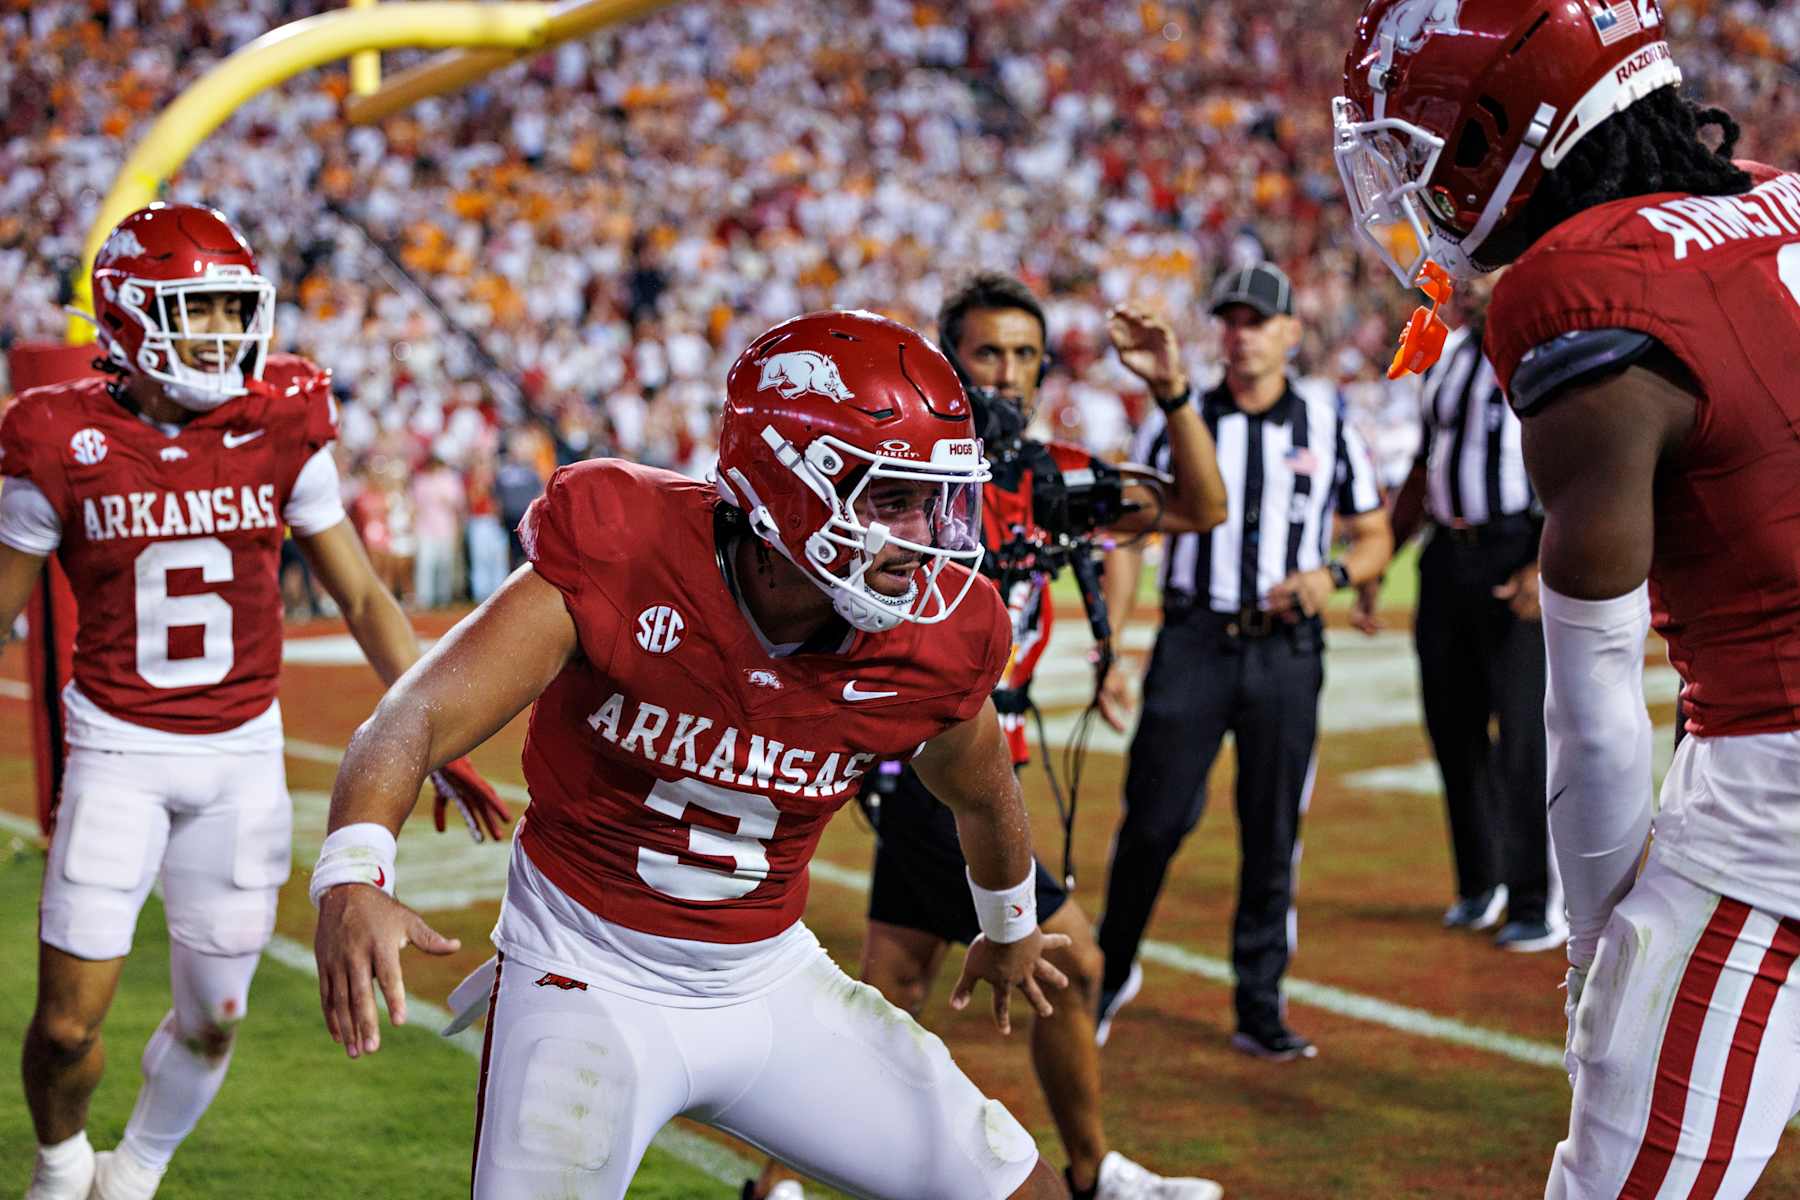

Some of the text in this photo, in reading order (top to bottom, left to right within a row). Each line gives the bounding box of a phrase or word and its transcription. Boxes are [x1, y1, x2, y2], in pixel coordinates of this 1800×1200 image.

[71, 428, 108, 465] SEC
[875, 449, 917, 459] OAKLEY
[949, 443, 973, 456] HOGS
[83, 484, 278, 540] ARKANSAS
[134, 536, 235, 689] 6
[636, 605, 685, 653] SEC
[586, 692, 878, 798] ARKANSAS
[636, 776, 782, 902] 3
